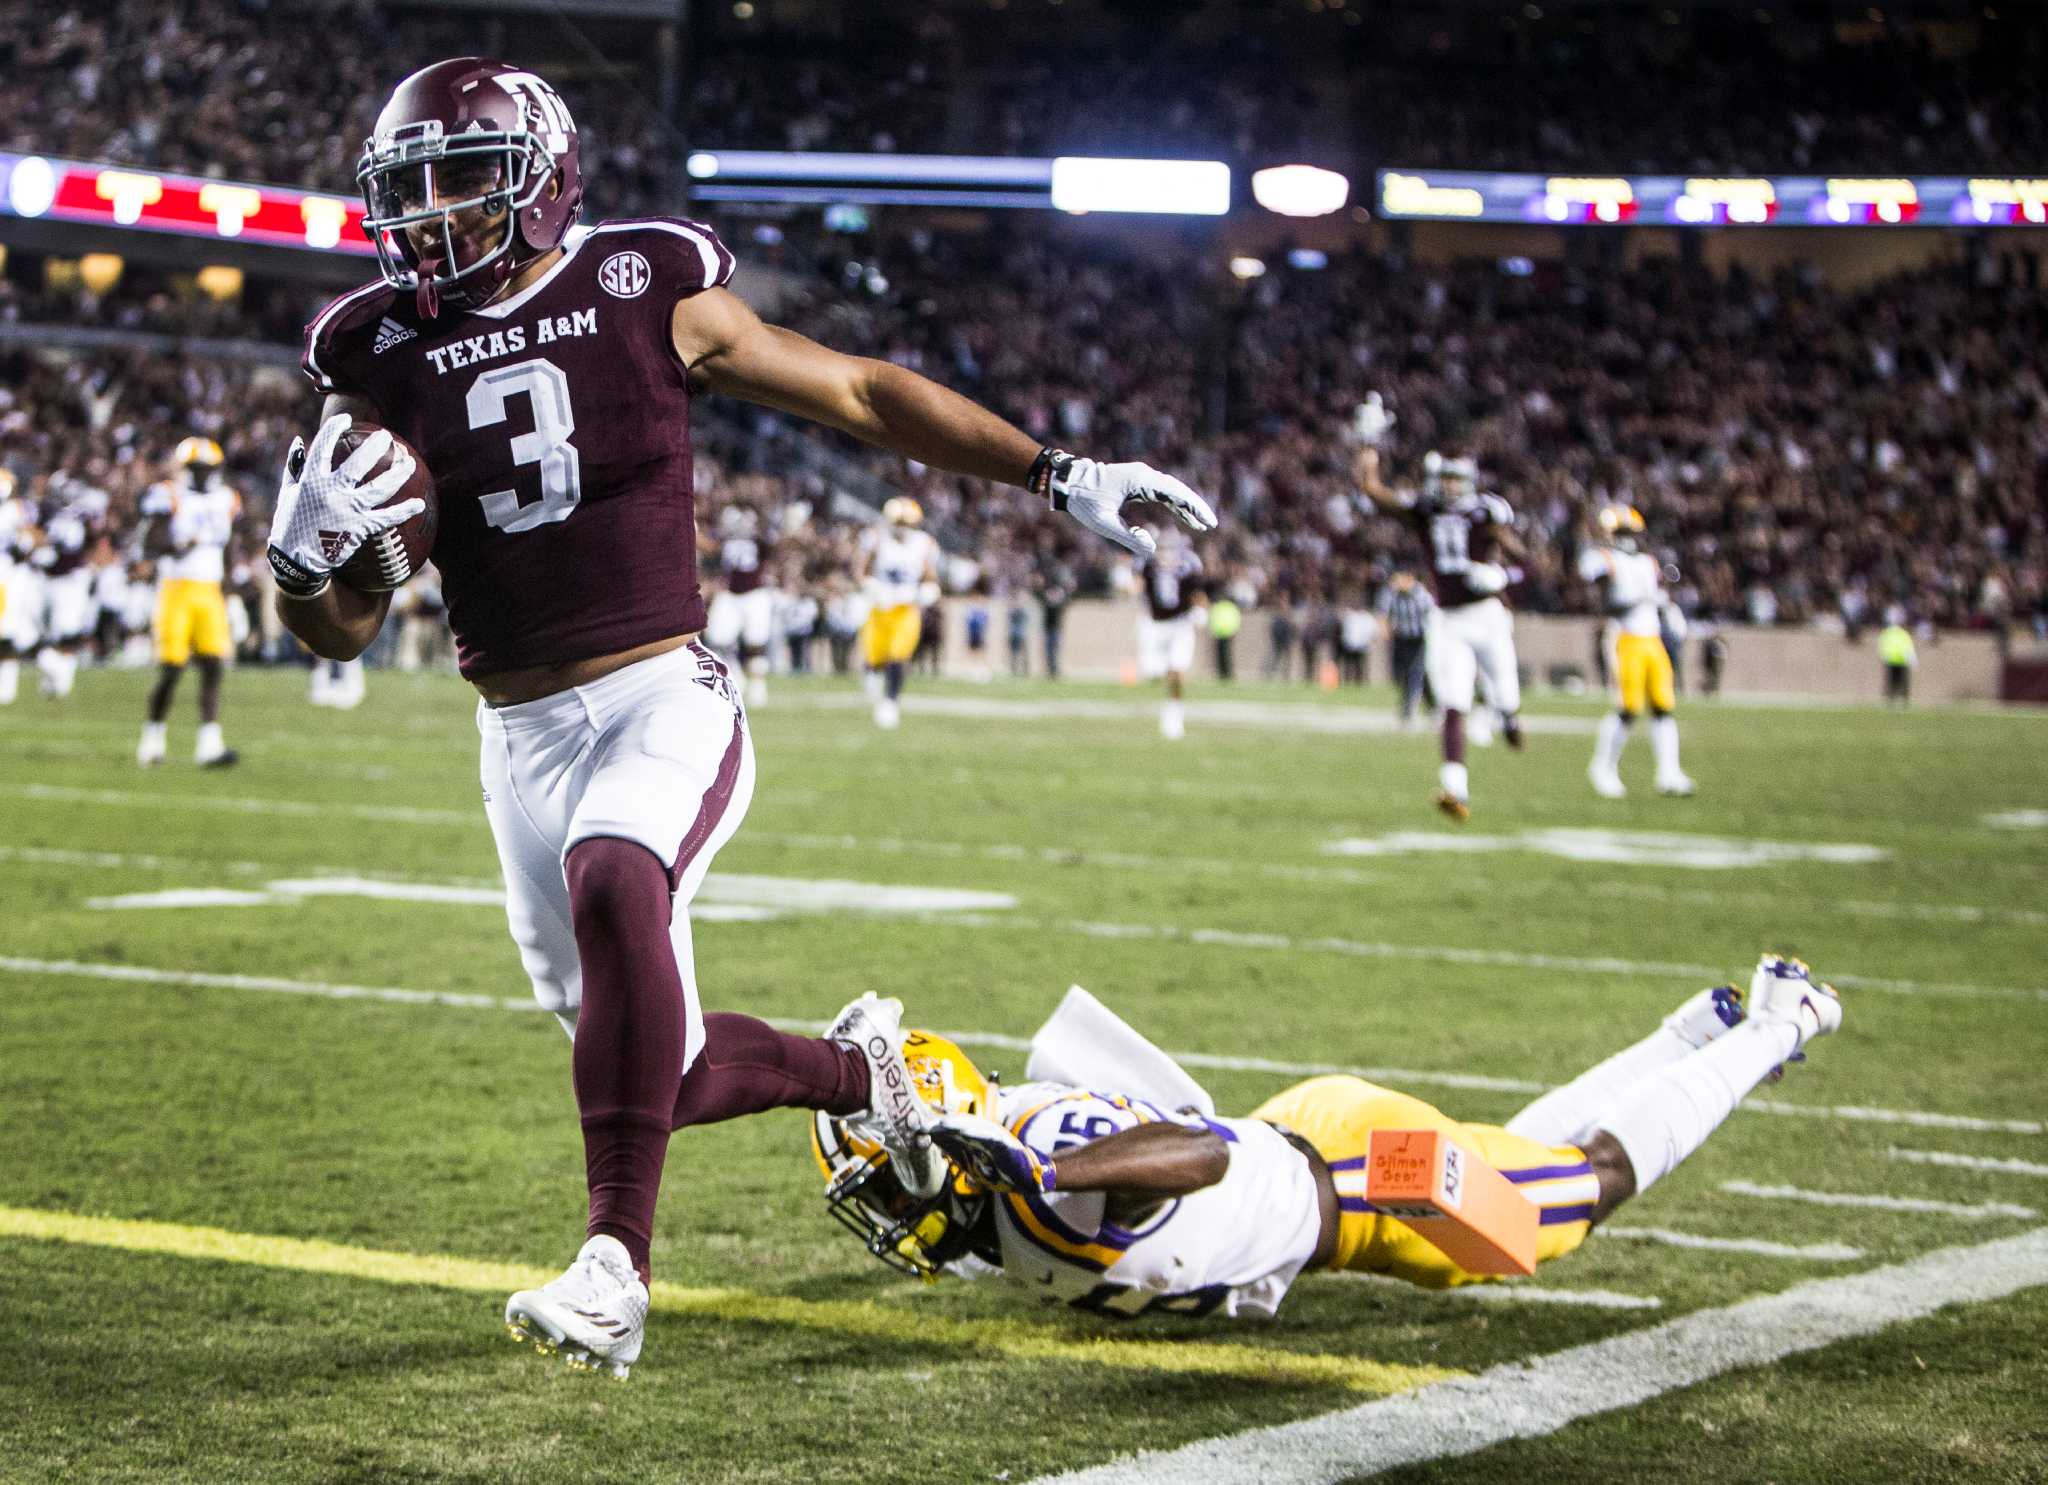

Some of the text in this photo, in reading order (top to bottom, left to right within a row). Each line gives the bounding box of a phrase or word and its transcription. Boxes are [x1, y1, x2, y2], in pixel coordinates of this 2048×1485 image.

[602, 254, 647, 294] SEC
[373, 326, 418, 354] adidas
[426, 307, 598, 375] TEXAS A&M
[465, 357, 582, 534] 3
[327, 530, 351, 562] adidas
[271, 552, 307, 582] adizero
[868, 1036, 922, 1134] dizero
[1375, 1155, 1426, 1169] Gilman
